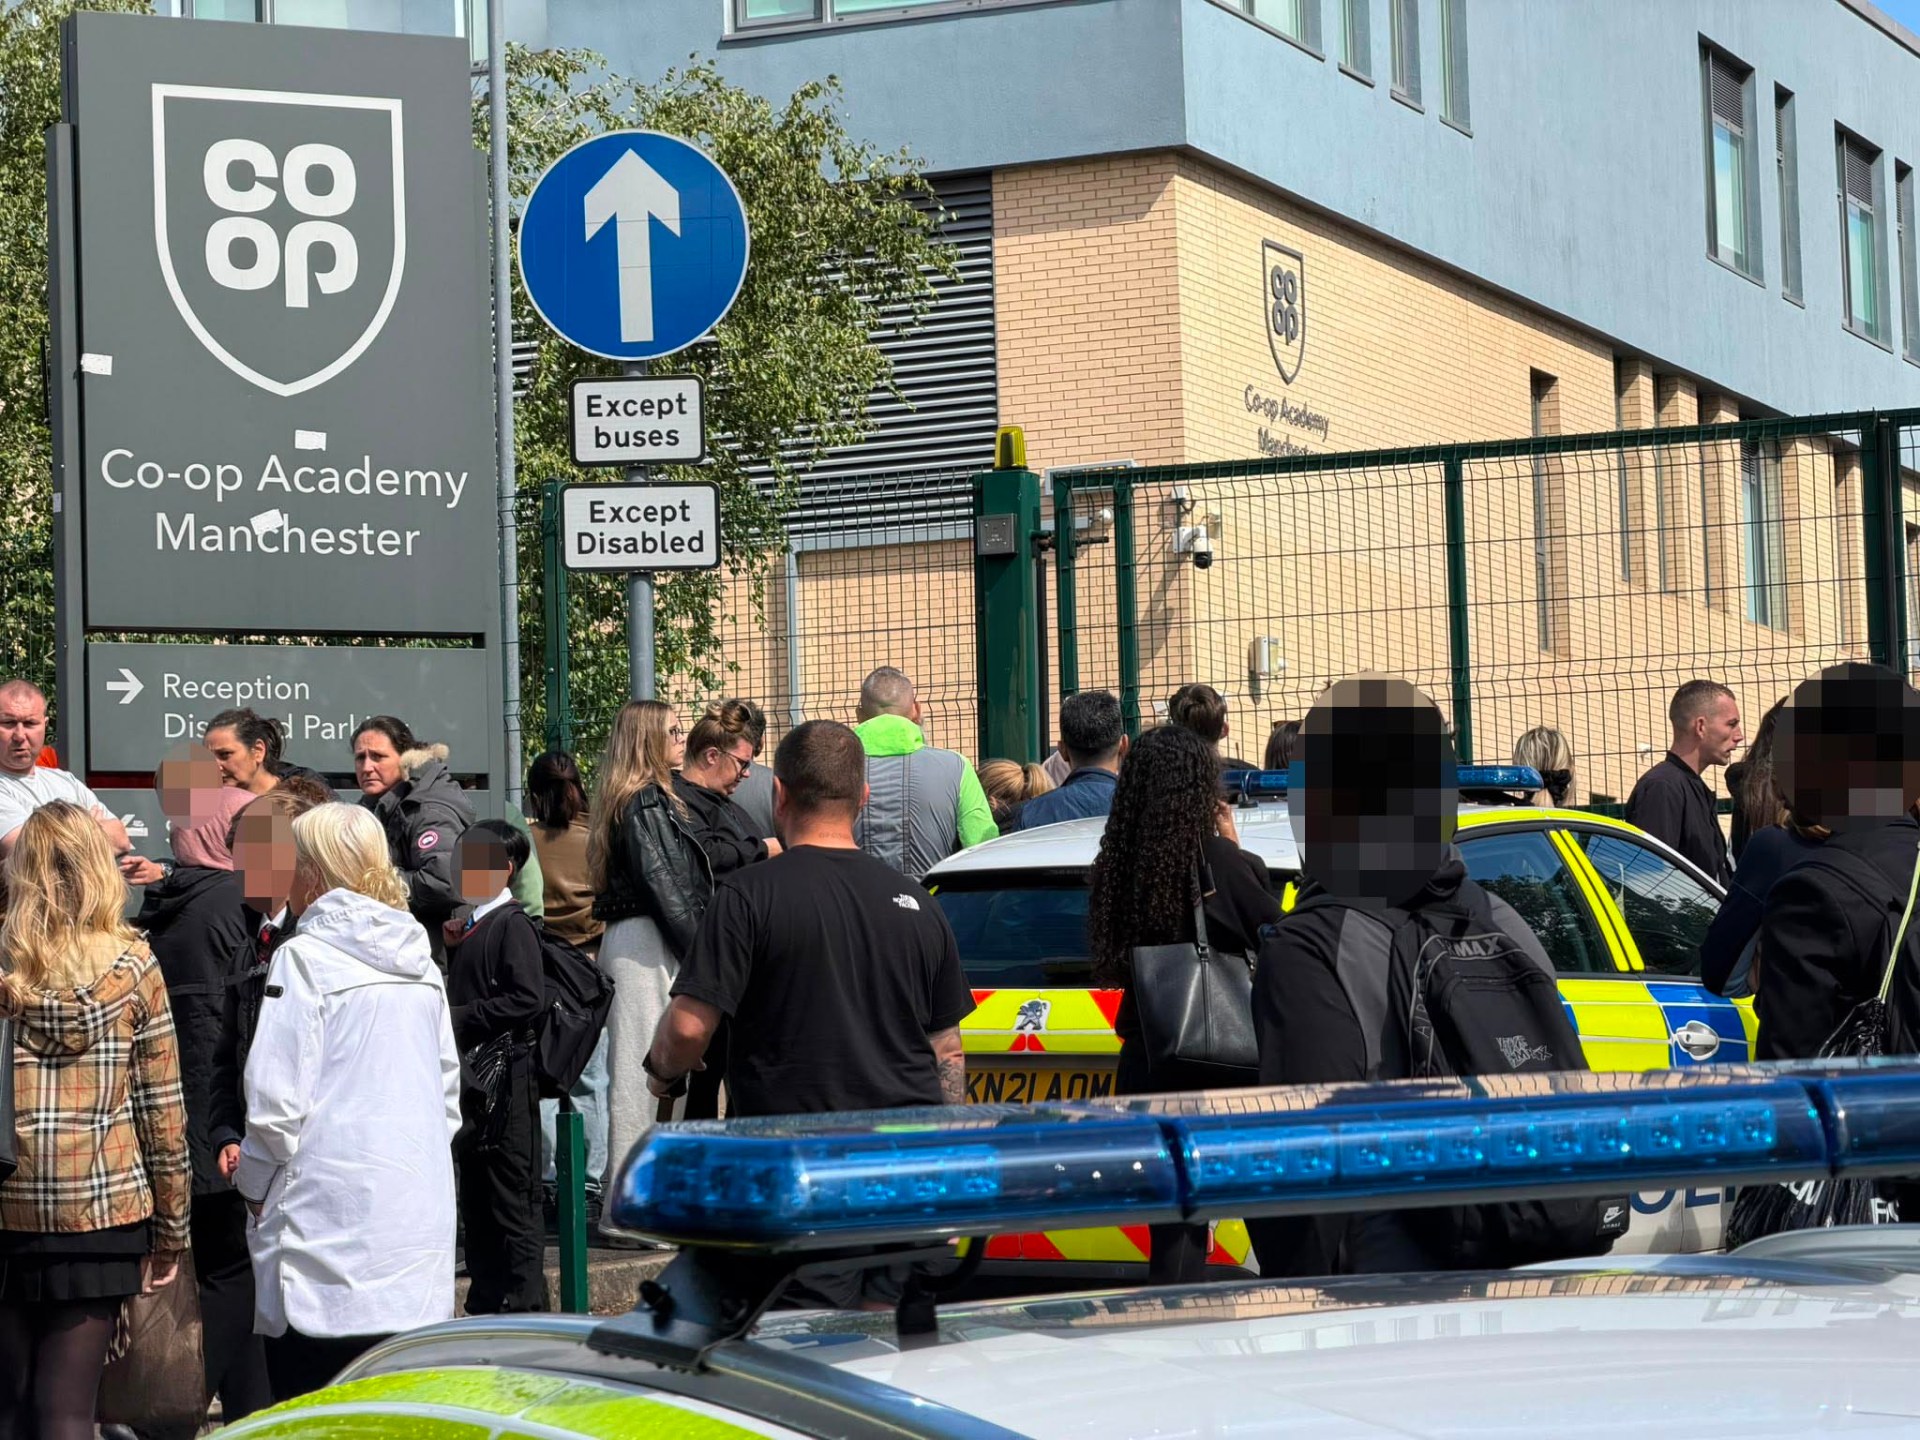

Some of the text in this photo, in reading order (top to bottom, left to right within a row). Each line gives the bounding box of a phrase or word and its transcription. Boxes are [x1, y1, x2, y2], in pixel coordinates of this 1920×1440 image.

[586, 392, 687, 419] Except
[1245, 384, 1330, 443] Co-op Academy
[595, 426, 680, 448] buses
[101, 448, 468, 508] Co-op Academy
[589, 499, 691, 526] Except
[156, 512, 421, 555] Manchester
[577, 530, 704, 555] Disabled
[163, 673, 310, 706] Reception
[164, 713, 293, 739] Disd
